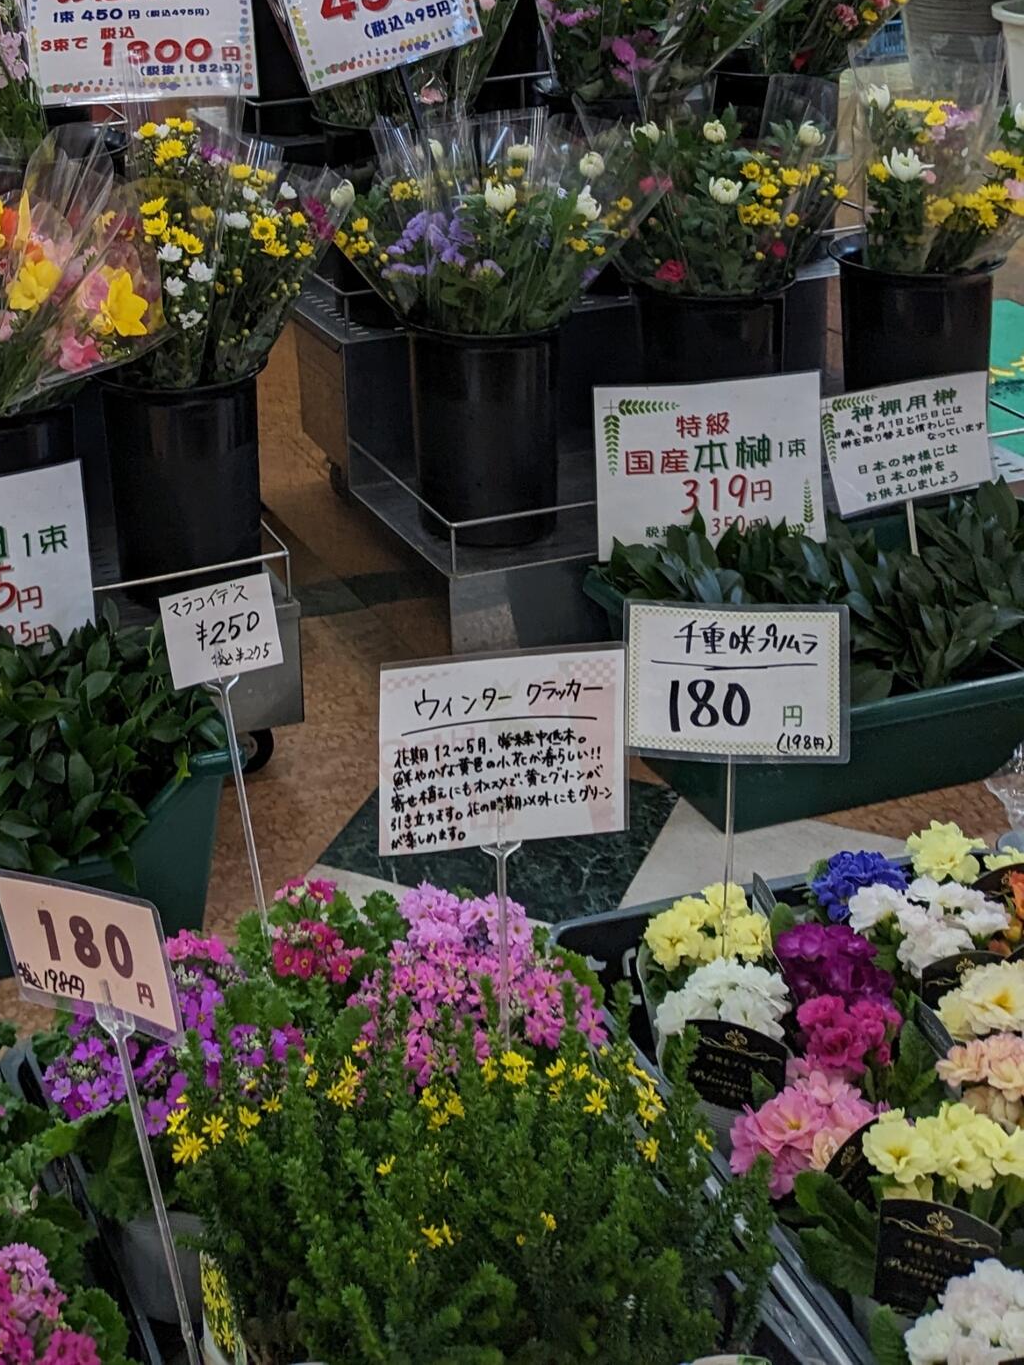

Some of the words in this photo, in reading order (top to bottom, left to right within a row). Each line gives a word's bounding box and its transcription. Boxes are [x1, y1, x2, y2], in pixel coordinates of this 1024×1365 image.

[100, 26, 135, 40] 税込
[851, 387, 958, 423] 神棚用榊
[676, 411, 730, 439] 特級
[927, 422, 985, 441] なっています
[858, 443, 959, 475] 日本の神様には
[876, 461, 945, 485] 日本の榊を
[866, 470, 959, 503] お供えしましょう
[168, 583, 249, 617] マラコイデス
[196, 610, 260, 651] ¥250
[669, 679, 751, 732] 180
[37, 909, 134, 979] 180
